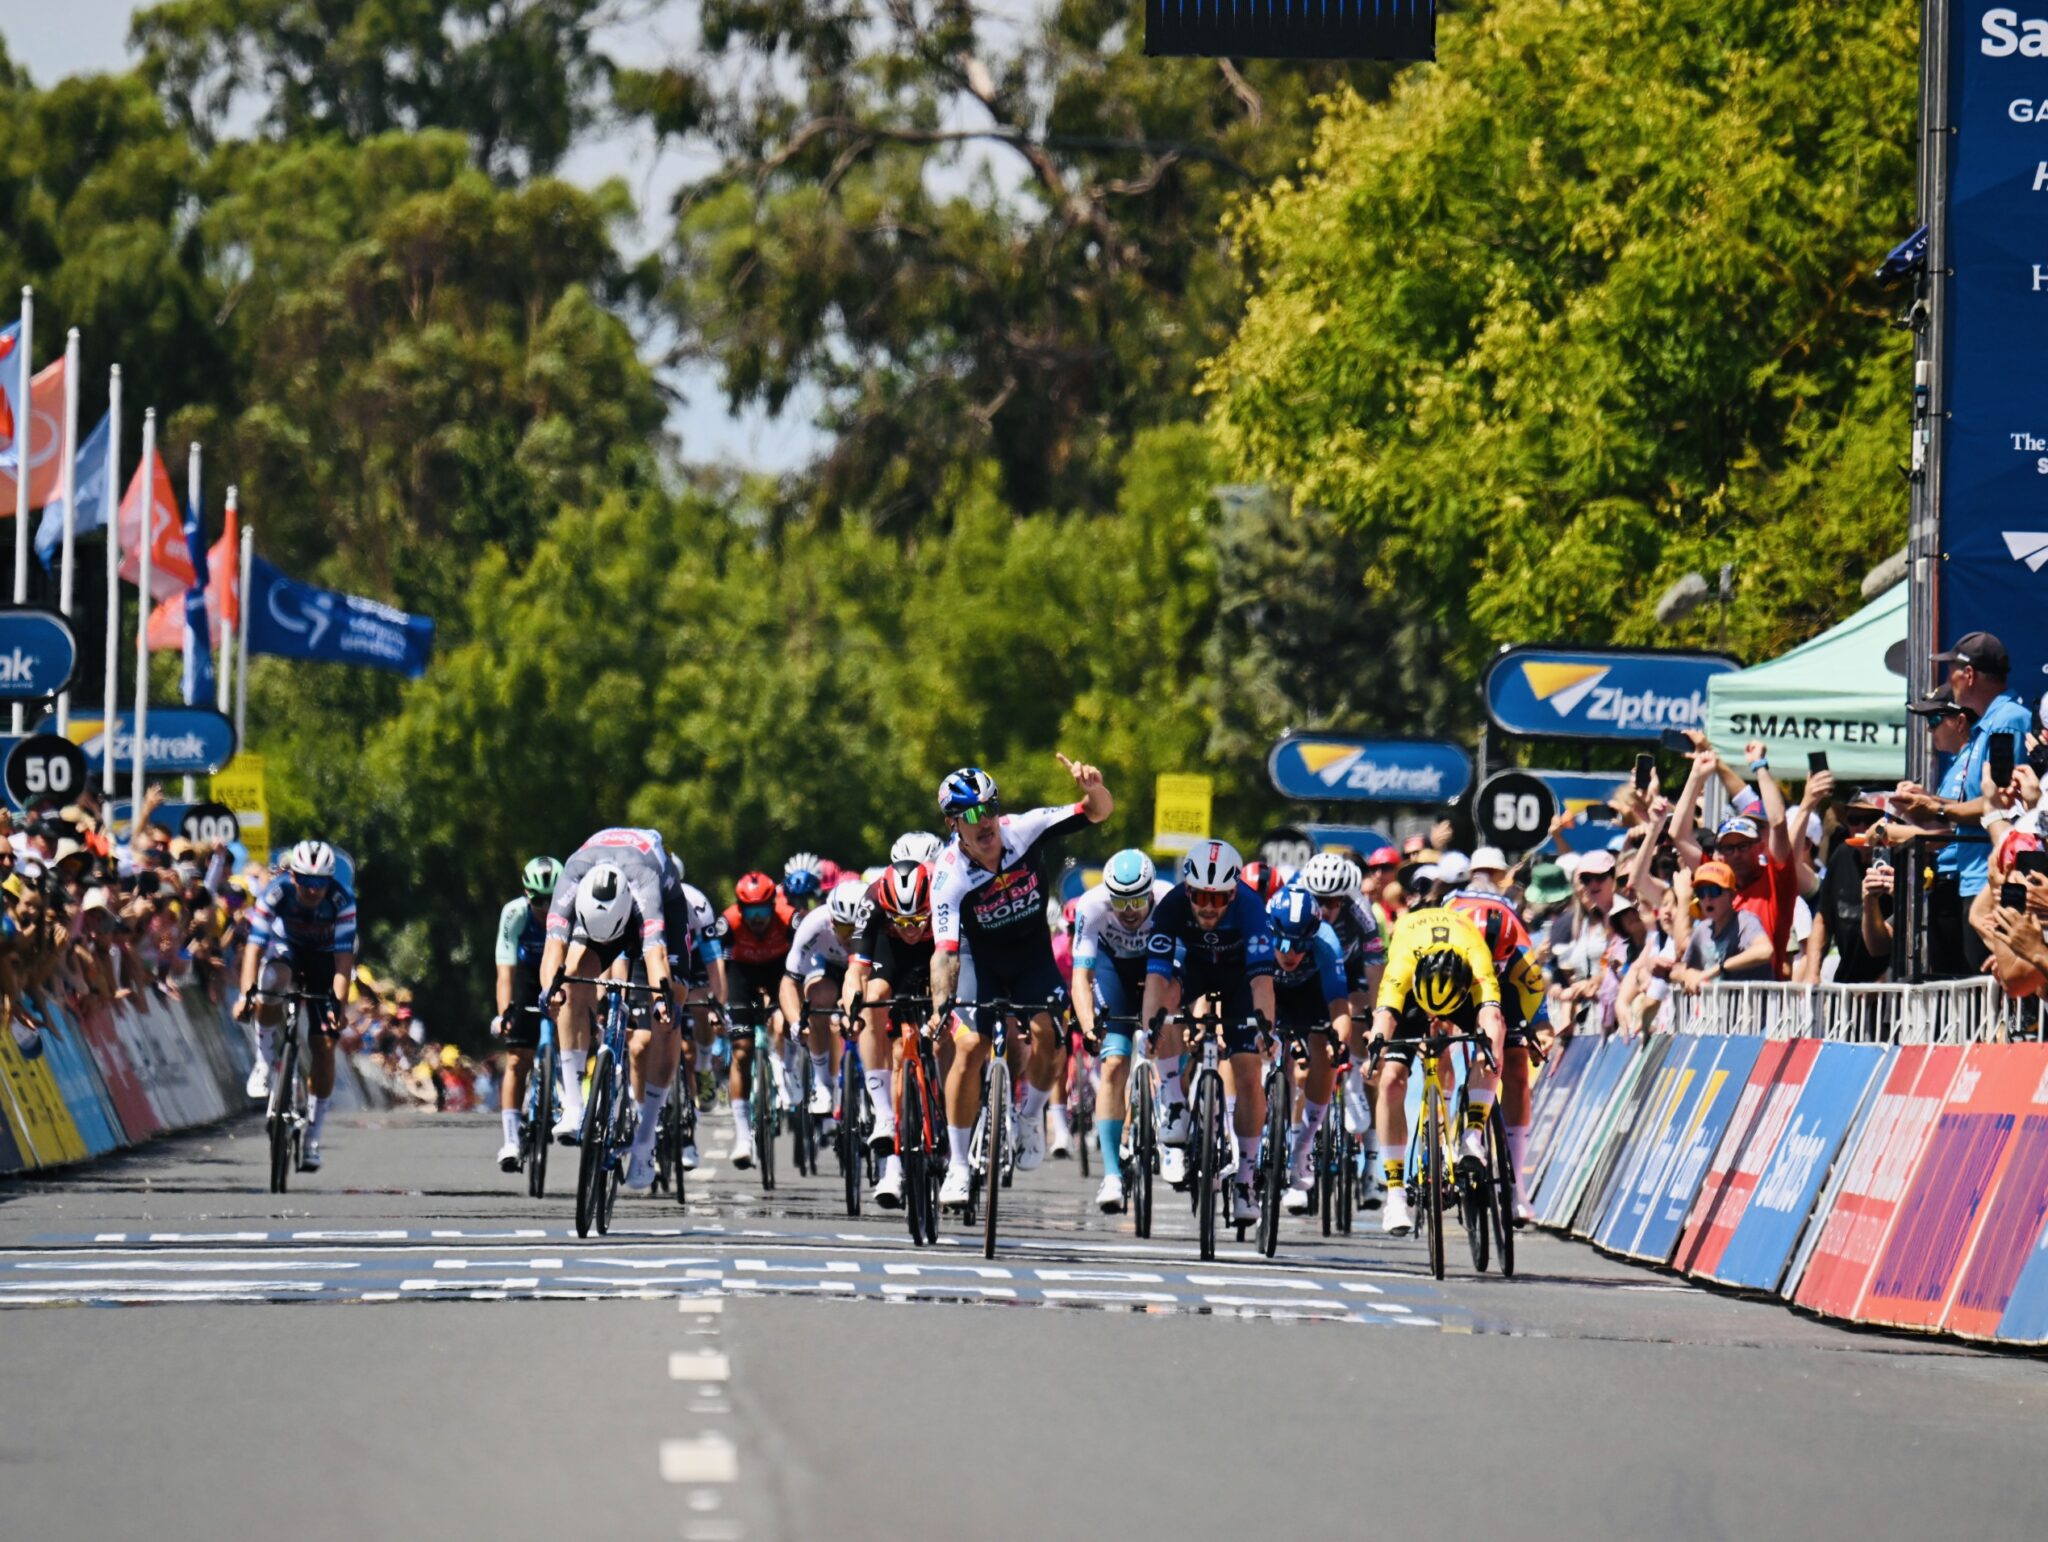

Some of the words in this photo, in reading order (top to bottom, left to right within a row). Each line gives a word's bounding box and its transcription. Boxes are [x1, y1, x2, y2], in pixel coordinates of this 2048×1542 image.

[1981, 8, 2048, 57] Sa
[2010, 432, 2047, 451] The
[1586, 687, 1709, 729] Ziptrak
[1729, 713, 1879, 745] SMARTER
[25, 757, 71, 792] 50
[1346, 761, 1444, 796] Ziptrak
[183, 815, 235, 843] 100
[1493, 793, 1541, 832] 50
[851, 896, 876, 940] INEOS
[937, 903, 950, 934] BOSS
[976, 889, 1041, 924] BORA
